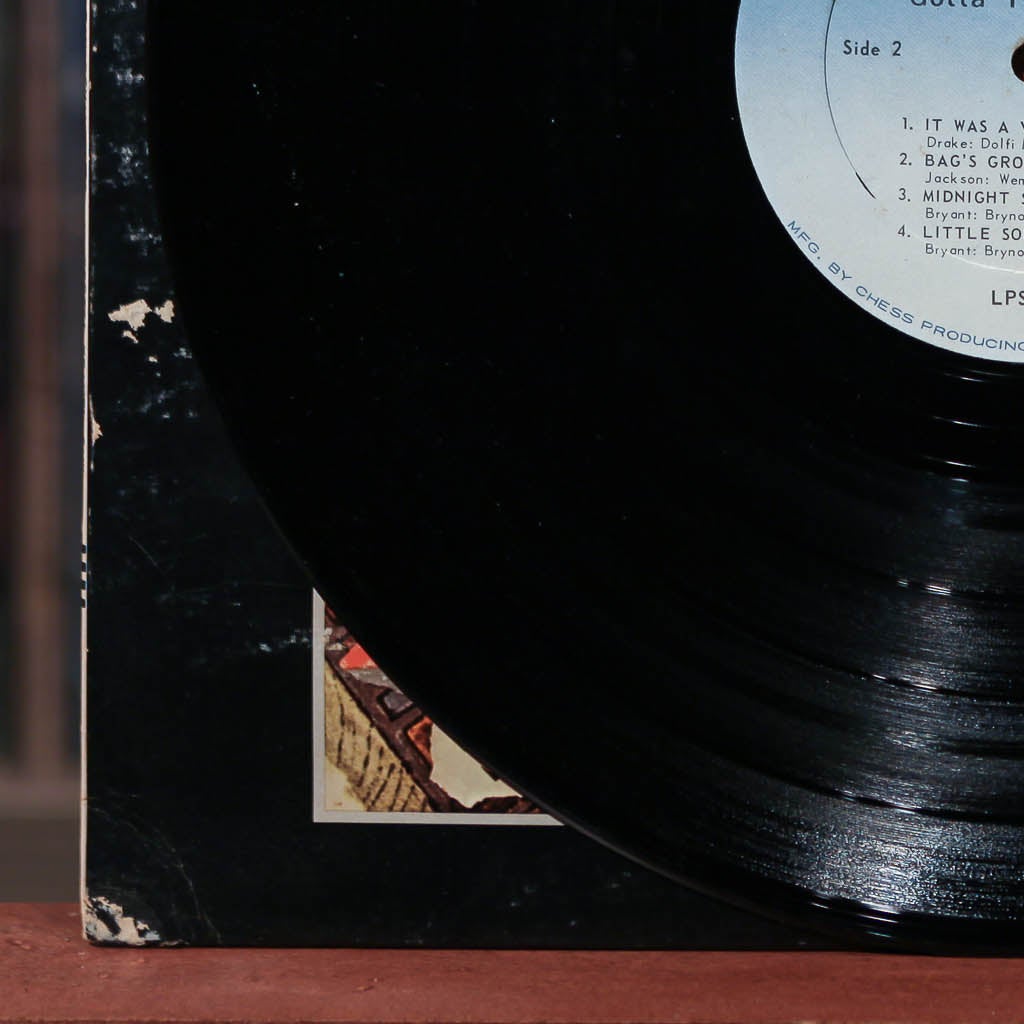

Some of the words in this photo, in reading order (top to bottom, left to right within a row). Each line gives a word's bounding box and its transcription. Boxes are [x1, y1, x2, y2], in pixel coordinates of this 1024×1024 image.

[842, 39, 881, 57] Side
[891, 40, 902, 57] 2
[902, 116, 914, 131] 1.
[925, 117, 943, 132] IT
[953, 119, 988, 134] WAS
[997, 120, 1009, 134] A
[927, 135, 973, 149] Drake:
[981, 137, 1015, 150] Dolfi
[899, 152, 913, 167] 2.
[924, 153, 977, 168] BAG'S
[924, 171, 989, 185] Jackson:
[898, 187, 911, 203] 3.
[922, 189, 1010, 205] MIDNIGHT
[925, 206, 977, 223] Bryant:
[897, 224, 911, 238] 4.
[923, 225, 991, 241] LITTLE
[925, 242, 977, 259] Bryant:
[787, 220, 821, 260] MFG.
[828, 262, 852, 282] BY
[855, 285, 915, 325] CHESS
